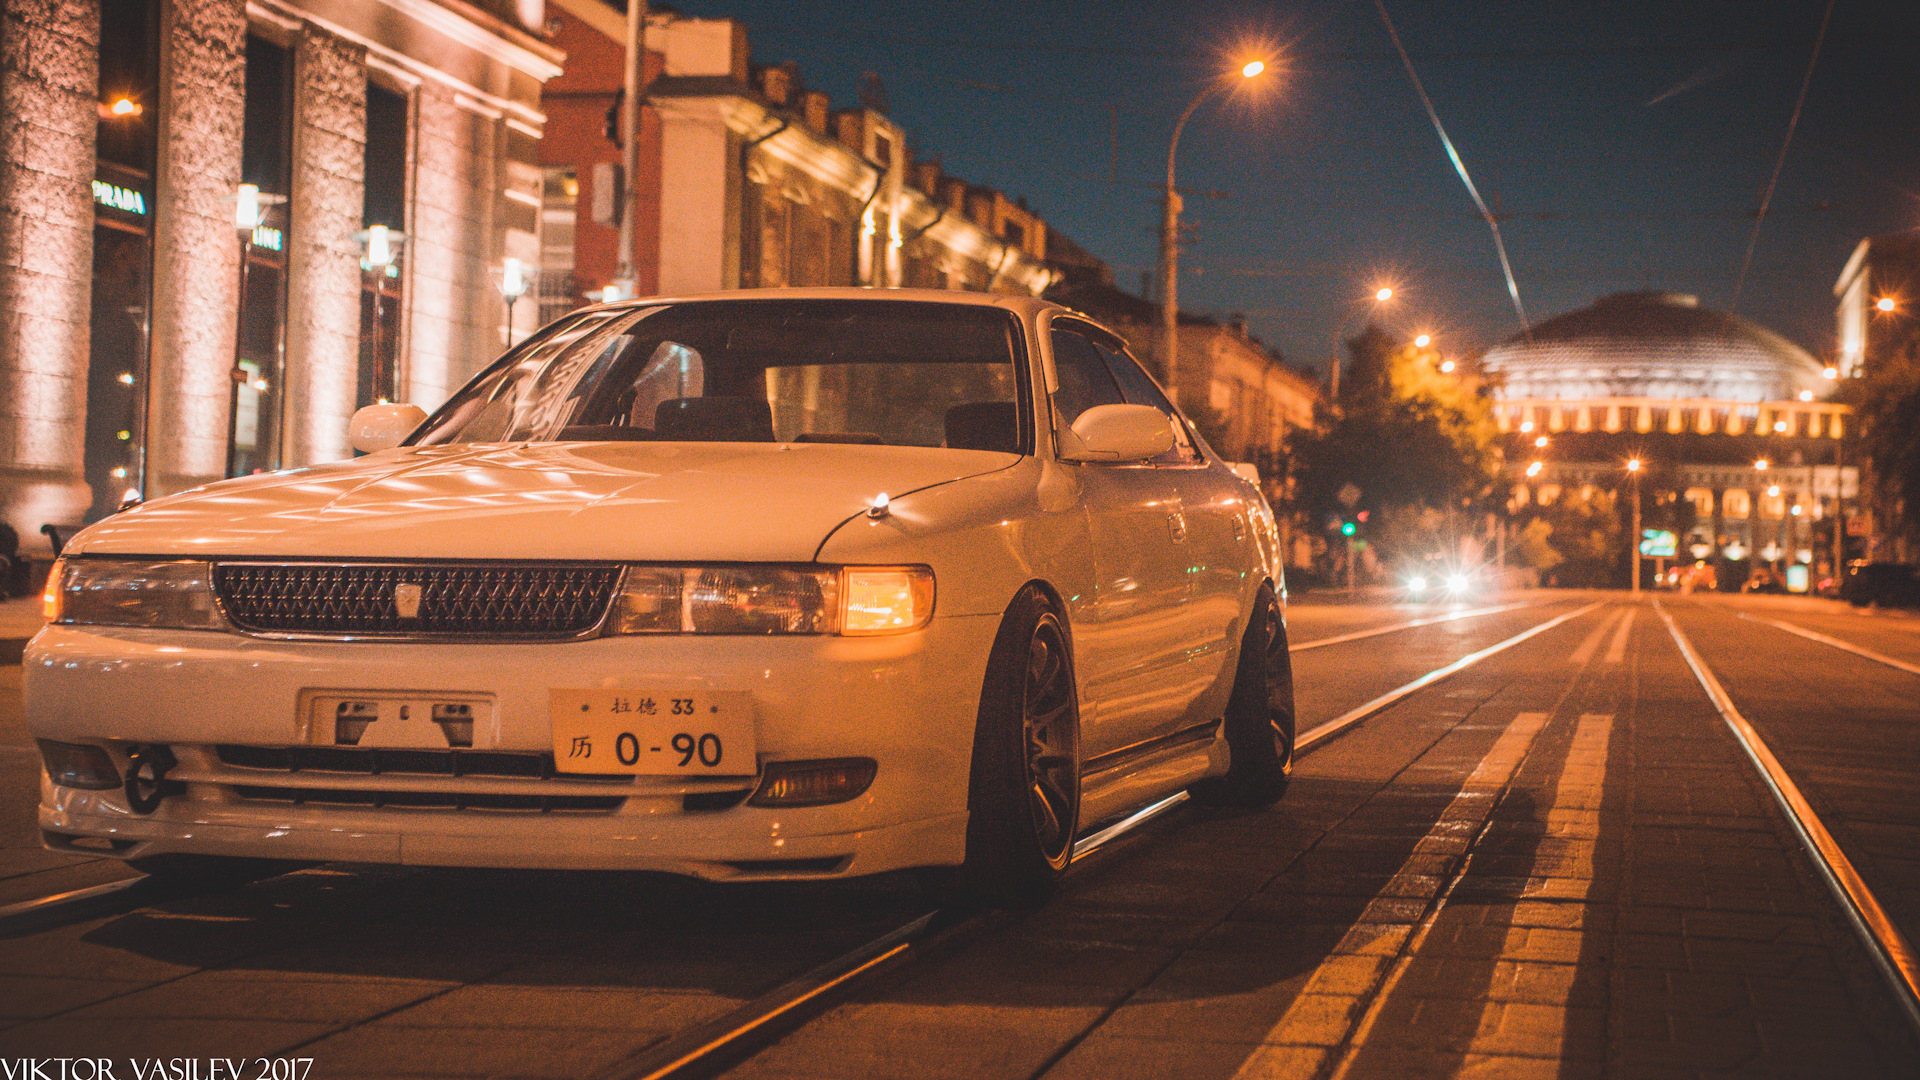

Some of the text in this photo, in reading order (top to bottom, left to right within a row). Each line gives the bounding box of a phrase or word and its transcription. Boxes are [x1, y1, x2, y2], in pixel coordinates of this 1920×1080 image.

[91, 180, 146, 215] PRADA
[671, 698, 694, 715] 33
[569, 735, 592, 758] 历
